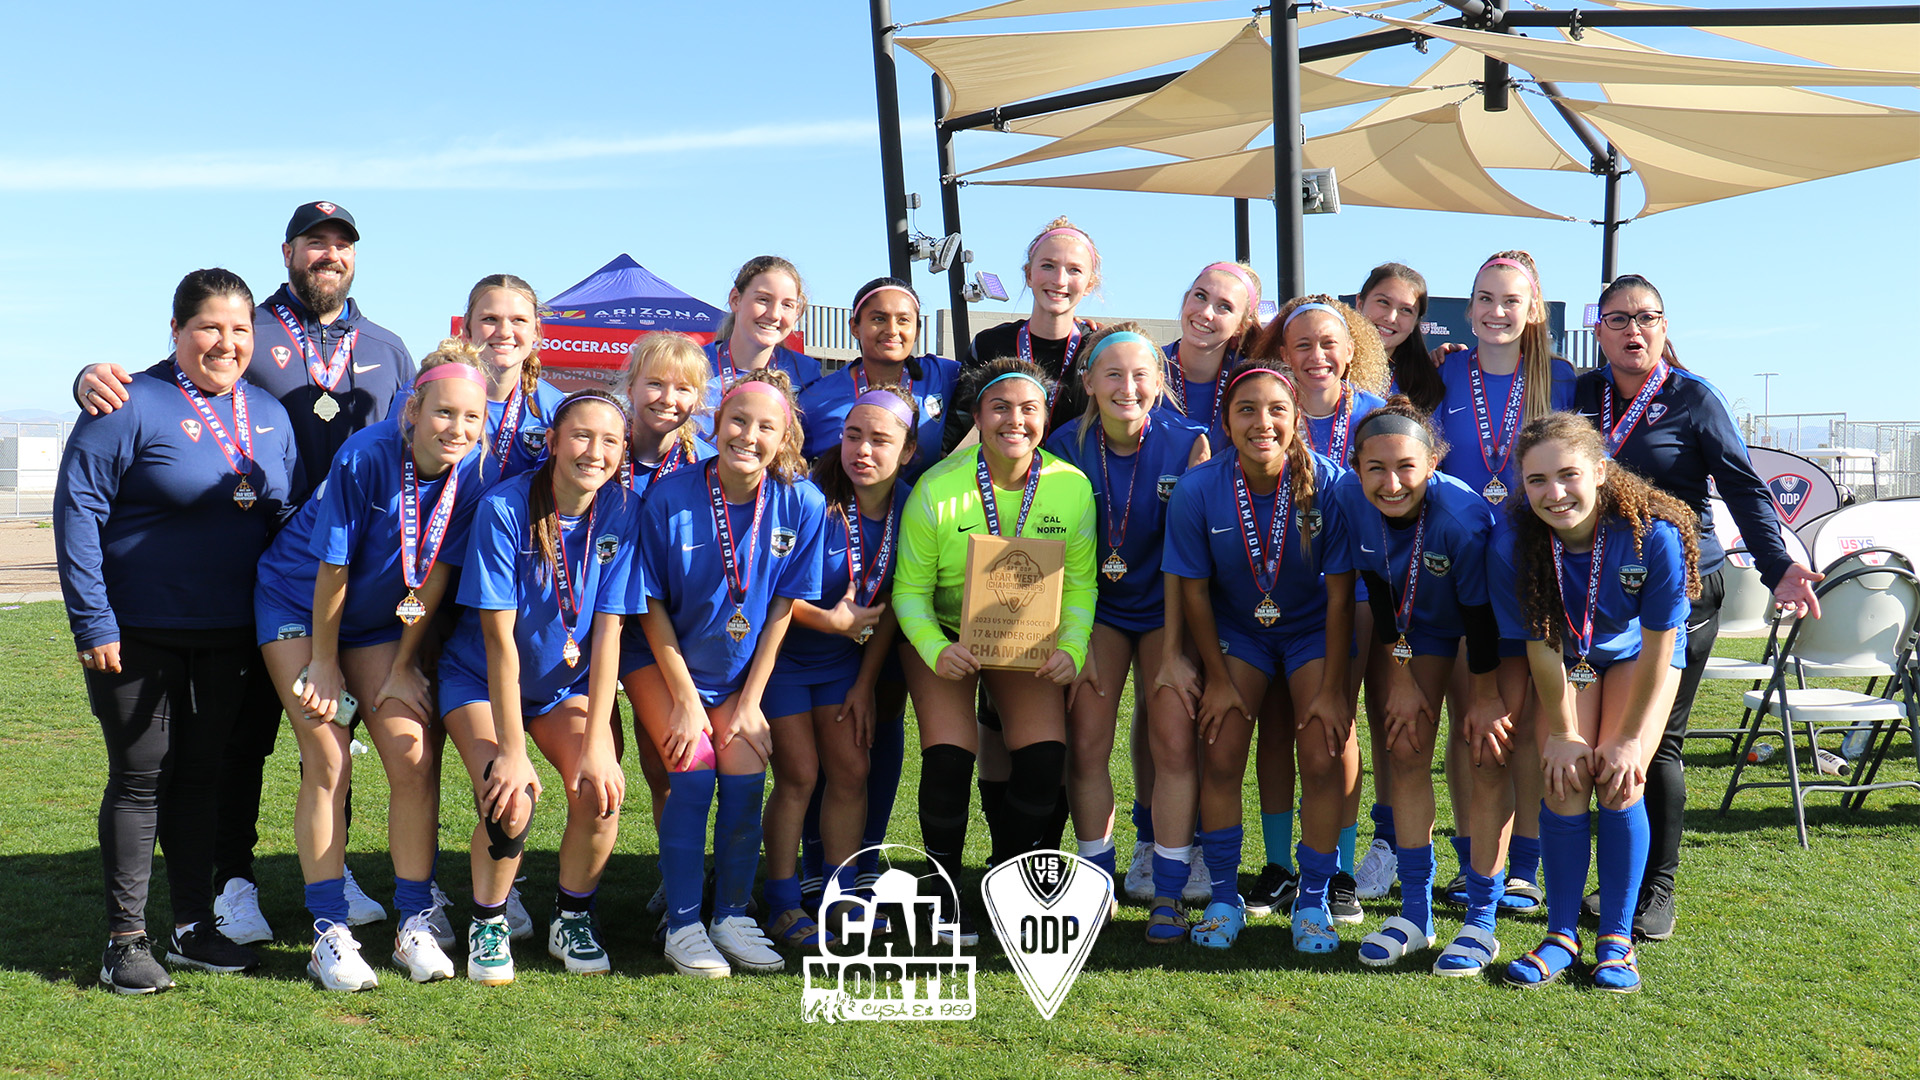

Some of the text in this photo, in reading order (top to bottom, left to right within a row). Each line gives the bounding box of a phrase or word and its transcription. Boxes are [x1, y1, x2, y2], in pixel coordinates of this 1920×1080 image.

[594, 308, 710, 318] ARIZONA
[1511, 375, 1523, 407] WEST
[1640, 374, 1659, 402] WEST
[176, 371, 227, 439] CHAMPION
[1471, 369, 1492, 440] CHAMPION
[1602, 383, 1611, 430] AMPION
[404, 461, 417, 548] CHAMPION
[977, 461, 999, 537] CHAMPION
[1278, 481, 1288, 517] WEST
[1780, 493, 1800, 505] ODP
[712, 487, 734, 569] CHAMPION
[1236, 479, 1261, 558] CHAMPION
[1840, 539, 1874, 550] USYS
[988, 581, 1044, 592] CHAMPIONSHIPS
[994, 572, 1039, 584] FAR WEST
[973, 629, 1051, 642] 17 & UNDER GIRLS
[1002, 618, 1025, 626] YOUTH
[970, 644, 1051, 660] CHAMPION
